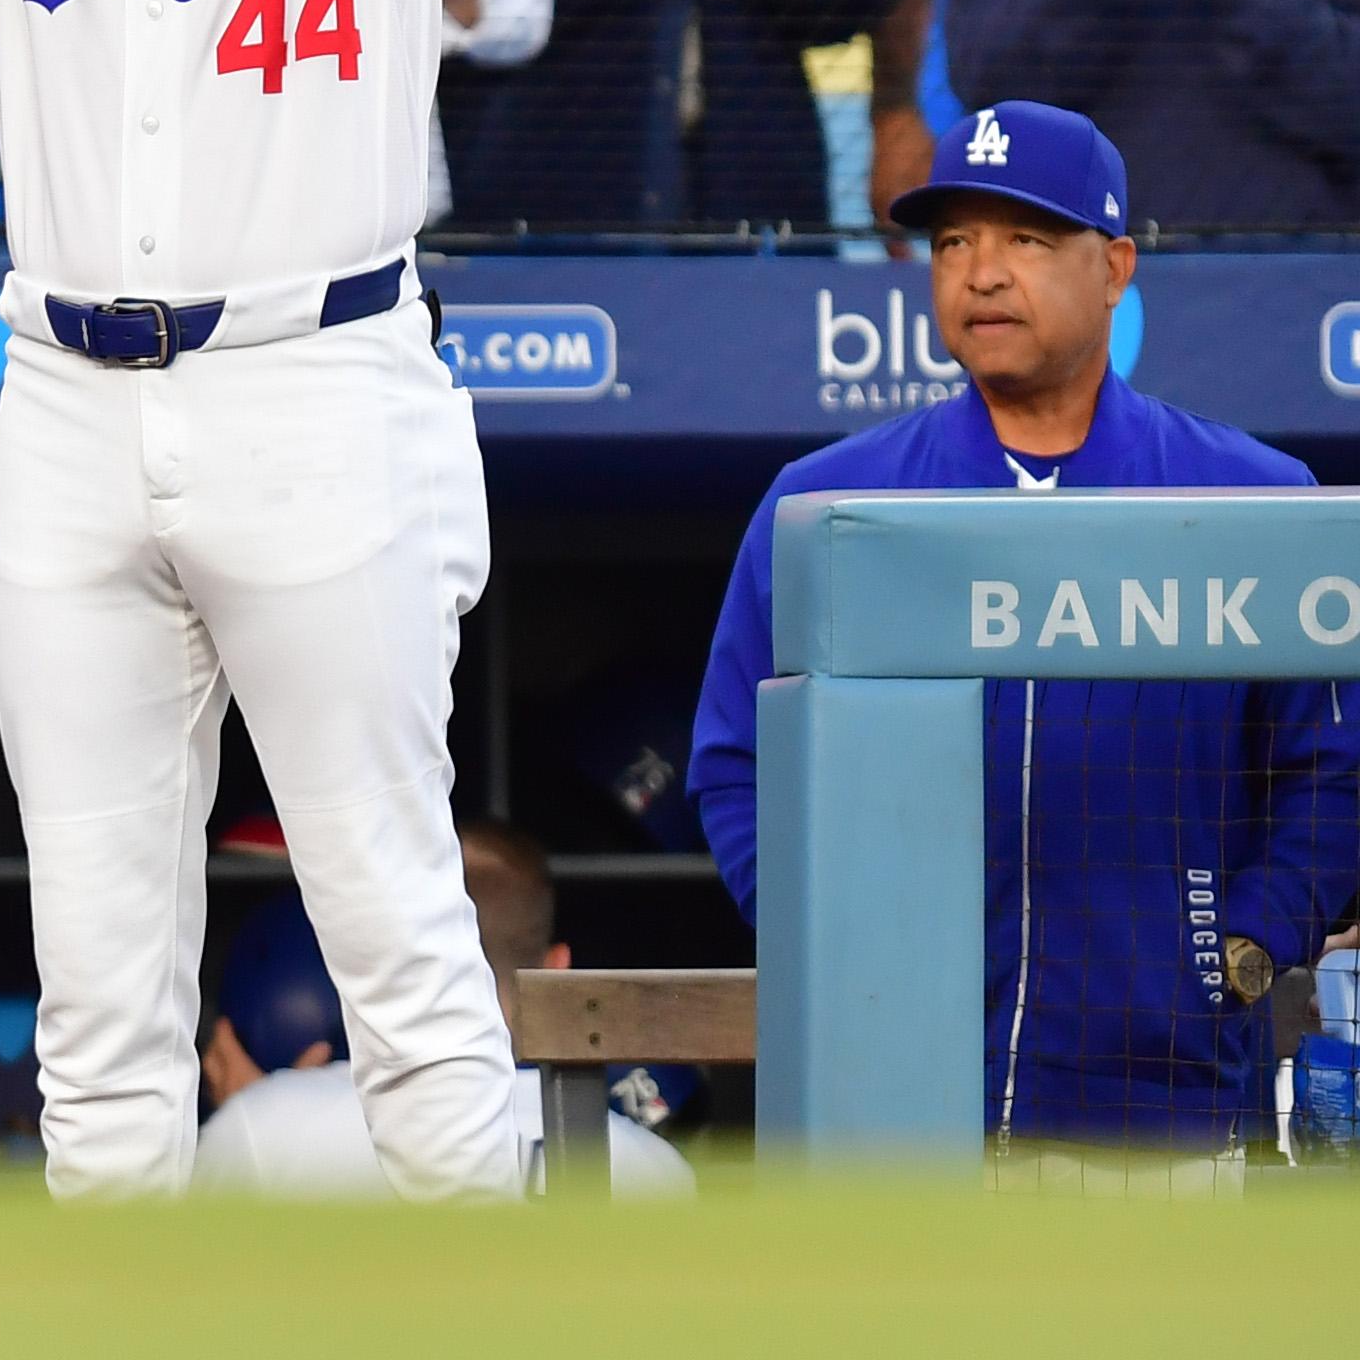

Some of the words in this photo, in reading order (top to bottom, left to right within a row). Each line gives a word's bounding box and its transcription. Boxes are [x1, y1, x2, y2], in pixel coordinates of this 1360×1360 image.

[966, 109, 1011, 167] LA
[971, 577, 1262, 648] BANK
[1298, 575, 1360, 646] O
